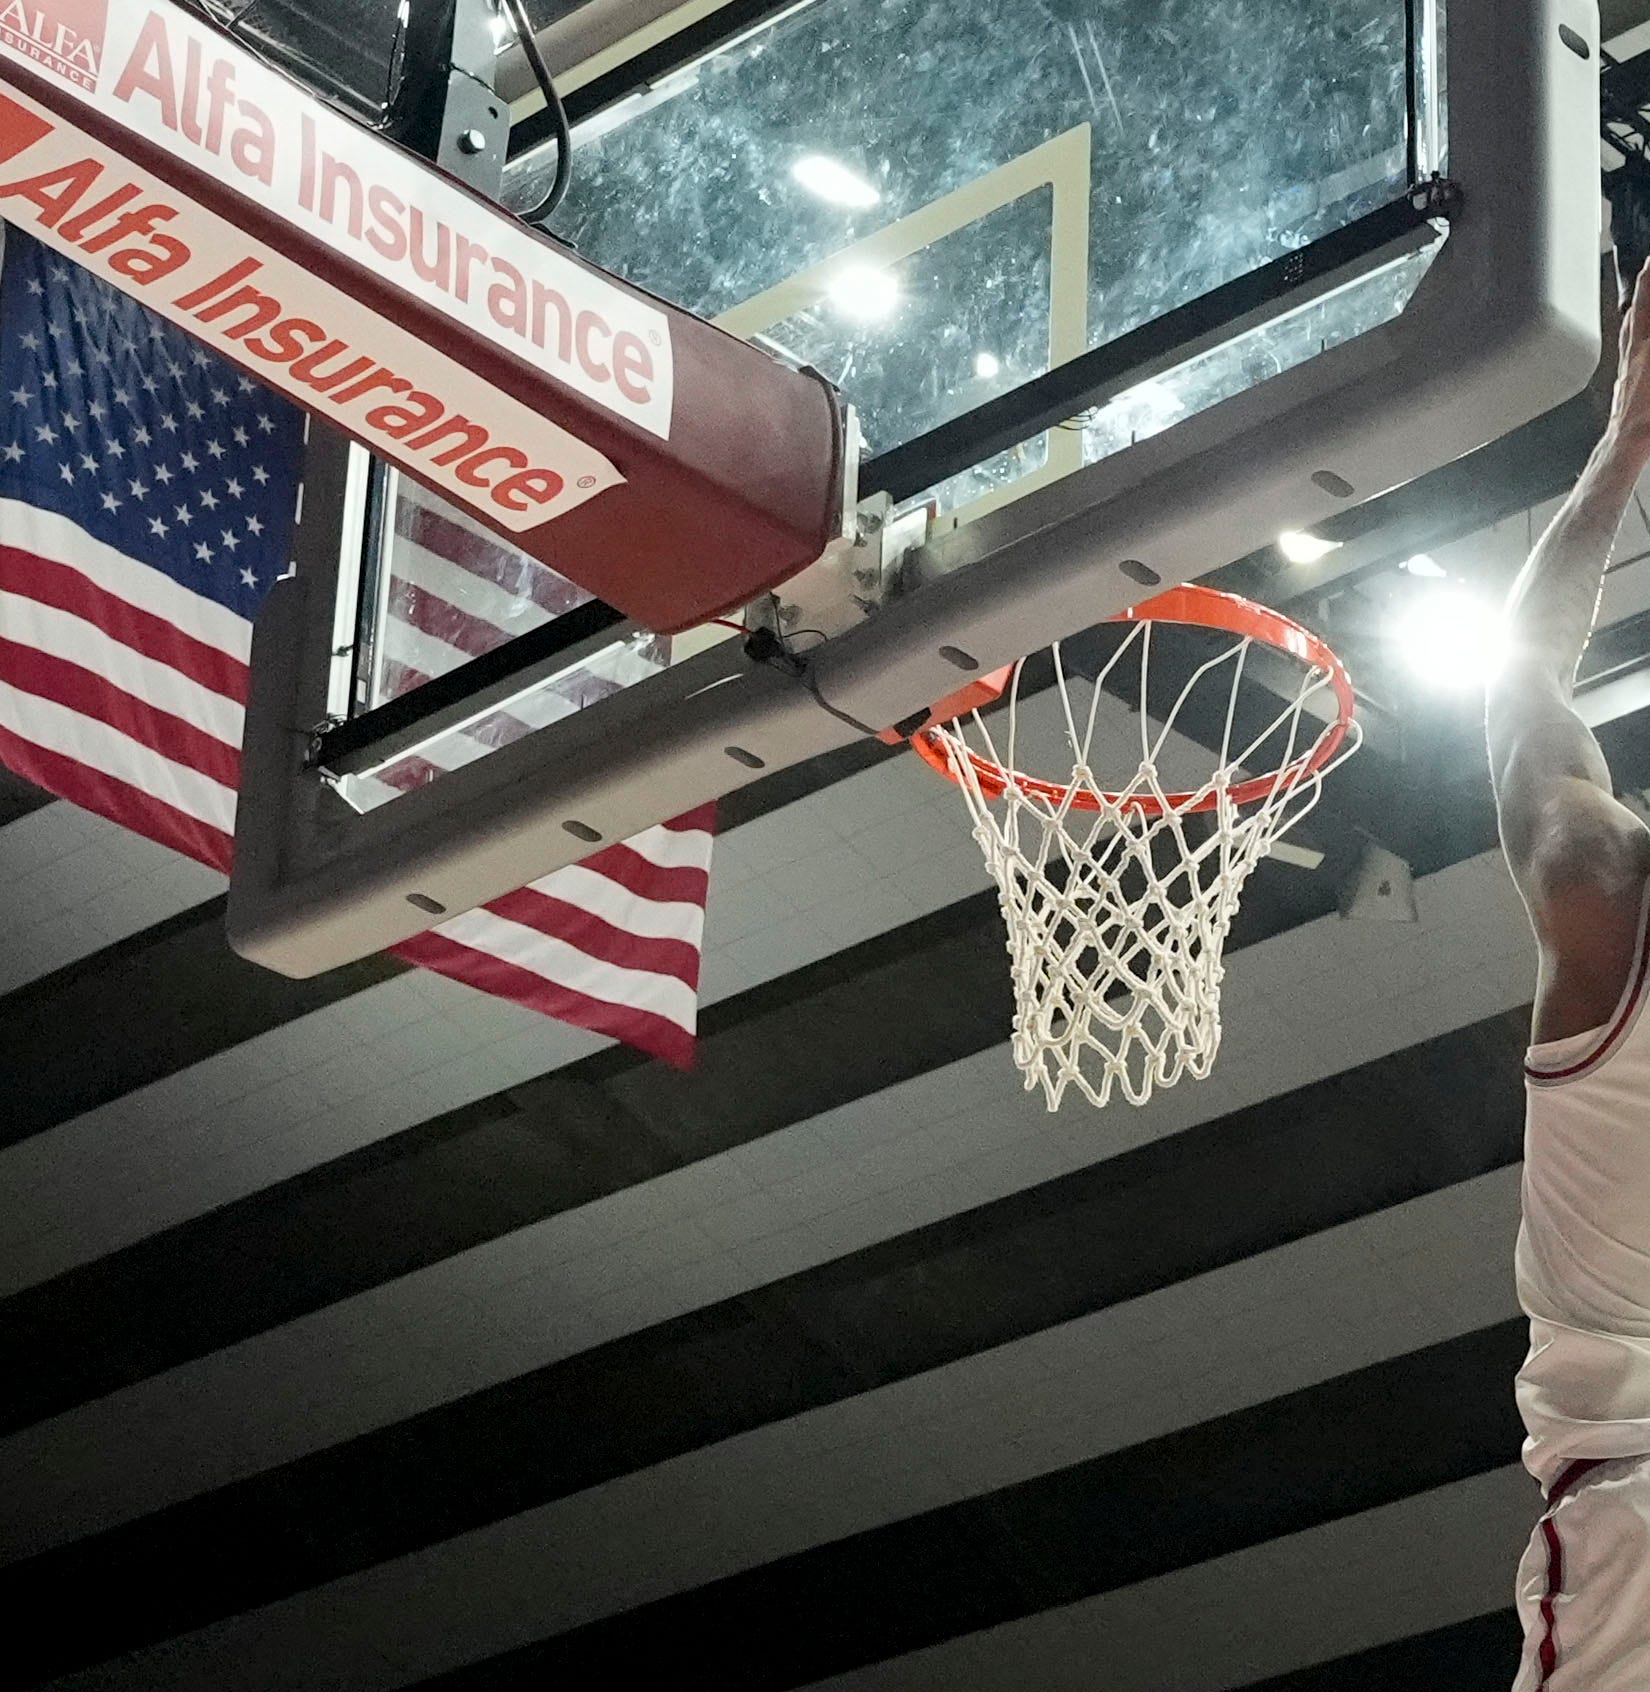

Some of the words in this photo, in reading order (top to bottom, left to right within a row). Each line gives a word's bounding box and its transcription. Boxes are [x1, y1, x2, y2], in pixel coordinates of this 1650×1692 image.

[0, 29, 92, 90] SURANCE
[112, 10, 276, 187] Alfa
[298, 111, 656, 404] Insurance
[0, 157, 191, 286] Alfa
[173, 256, 564, 512] Insurance
